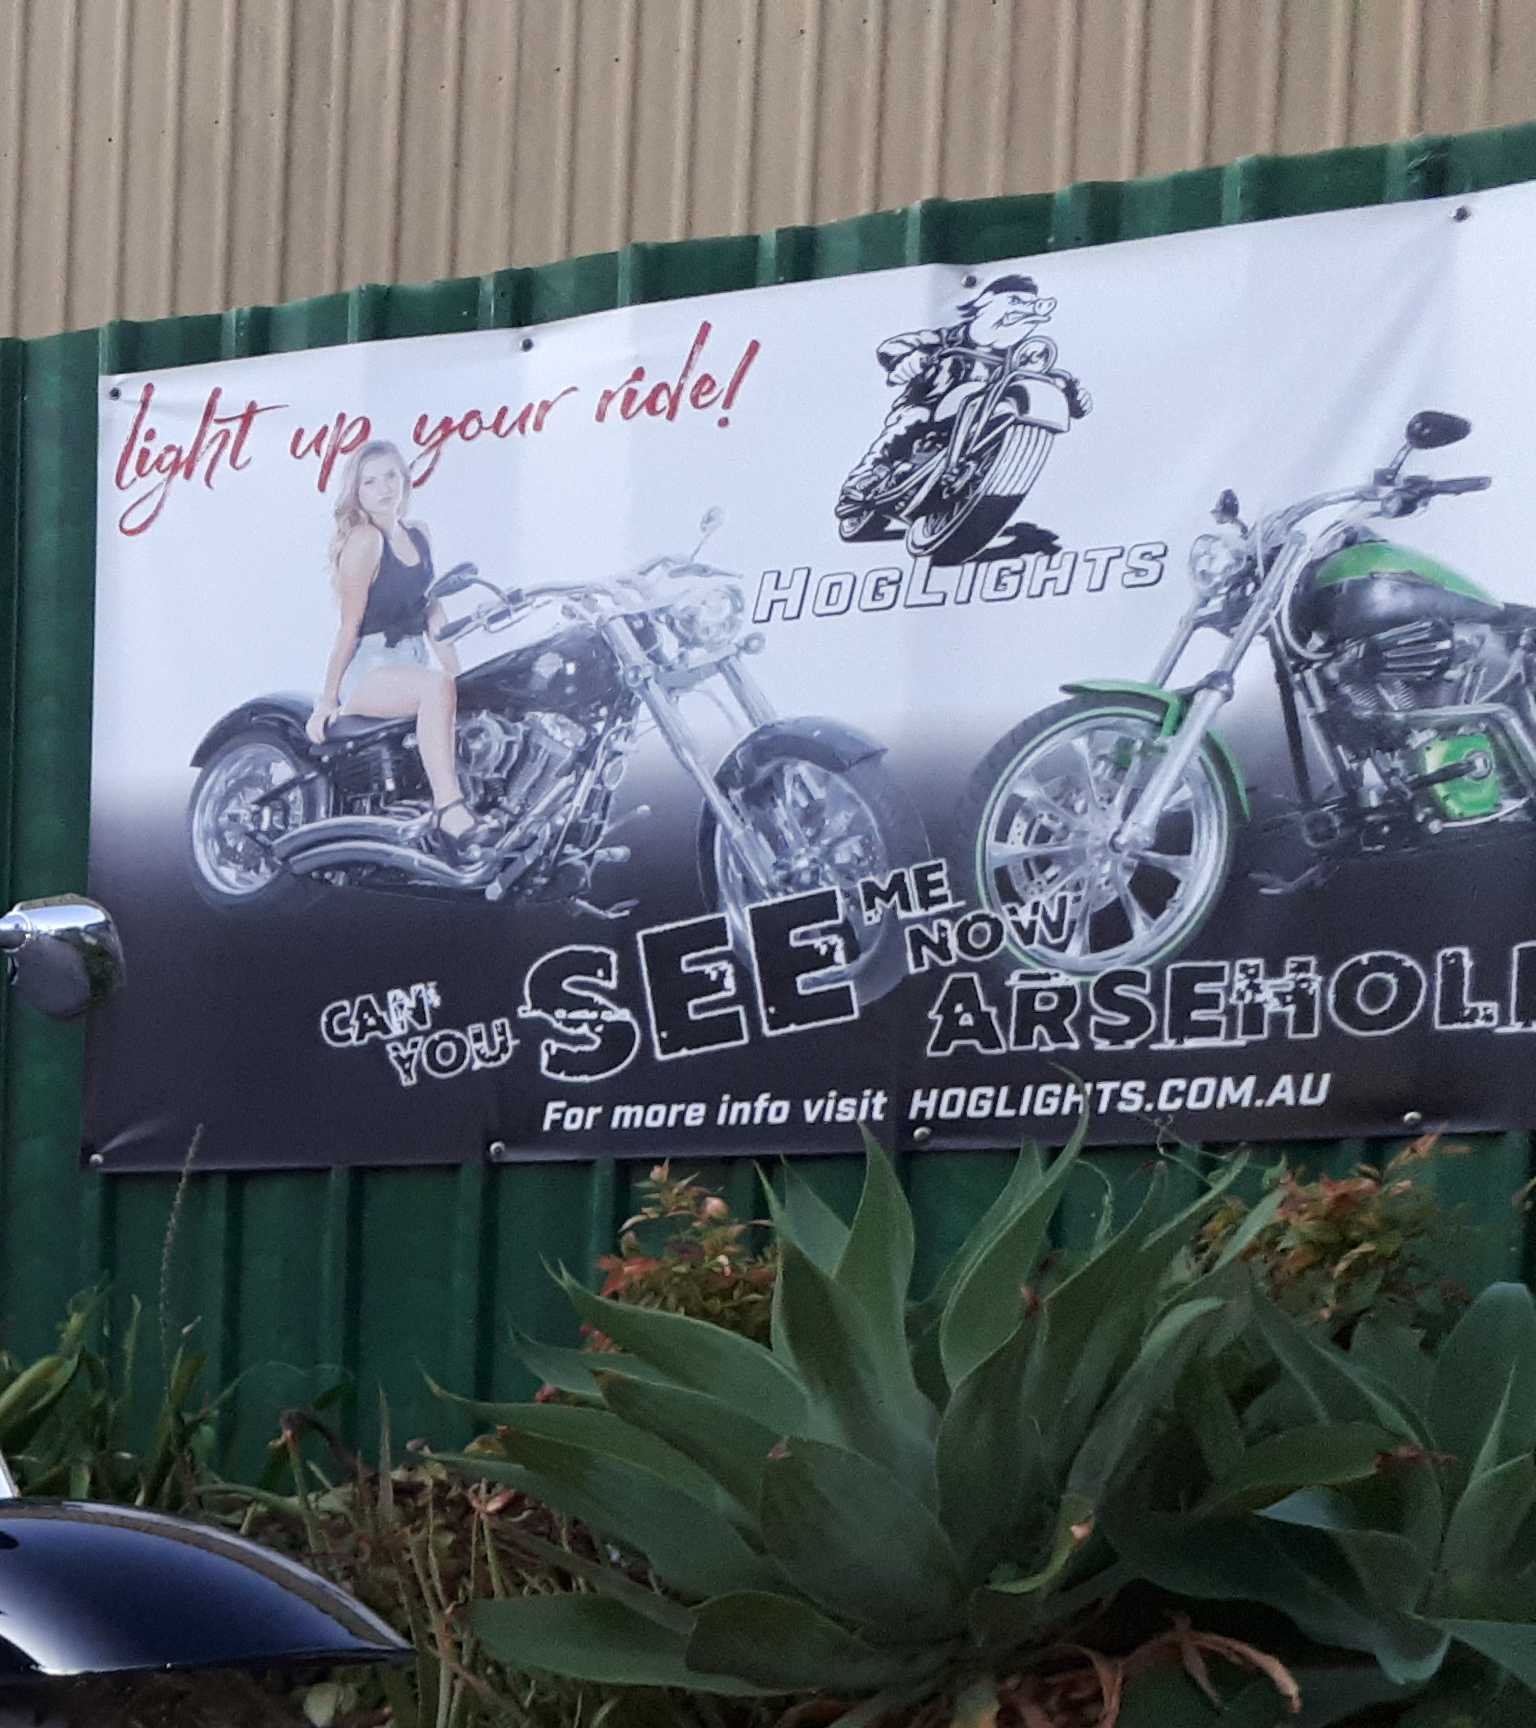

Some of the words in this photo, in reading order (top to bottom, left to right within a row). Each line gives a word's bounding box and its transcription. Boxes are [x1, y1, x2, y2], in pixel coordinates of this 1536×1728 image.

[114, 383, 289, 537] light
[289, 412, 370, 492] up
[412, 386, 579, 488] your
[595, 320, 761, 428] ride!
[859, 858, 964, 926] ME
[907, 893, 1075, 975] NOW
[321, 982, 440, 1047] CAN
[518, 885, 859, 1082] SEE
[387, 1018, 516, 1086] YOU
[542, 1100, 602, 1132] For
[610, 1102, 705, 1130] more
[717, 1094, 789, 1126] info
[804, 1090, 887, 1123] visit
[909, 1073, 1330, 1119] HOGLIGHTS.COM.AU
